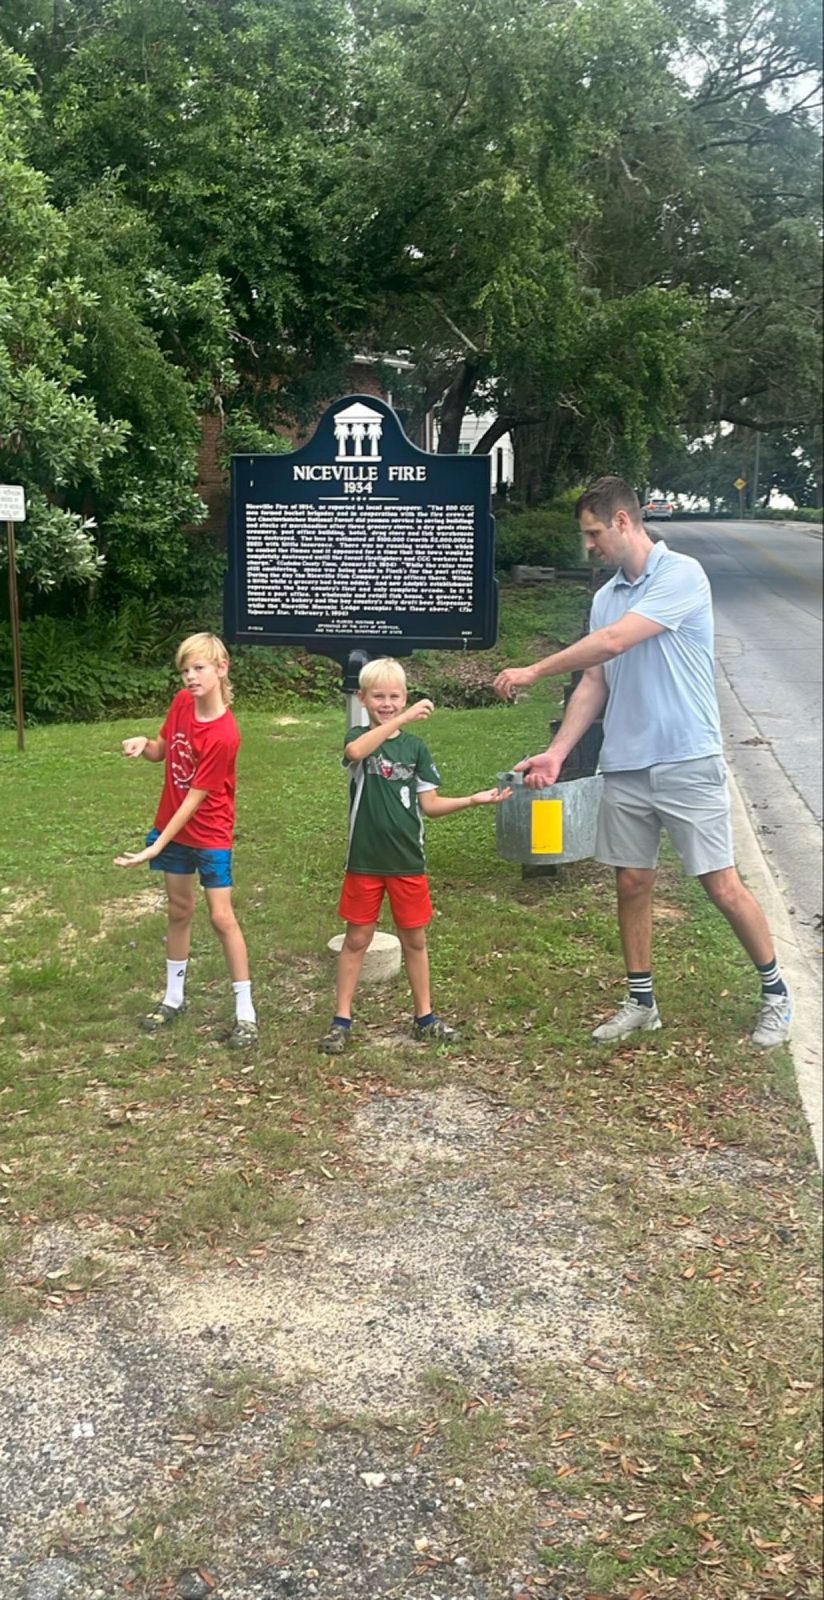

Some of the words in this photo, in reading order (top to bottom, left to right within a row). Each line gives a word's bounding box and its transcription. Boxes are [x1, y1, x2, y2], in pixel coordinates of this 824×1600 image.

[293, 465, 378, 481] NICEVILLE
[388, 466, 427, 481] FIRE
[343, 481, 373, 494] 1934
